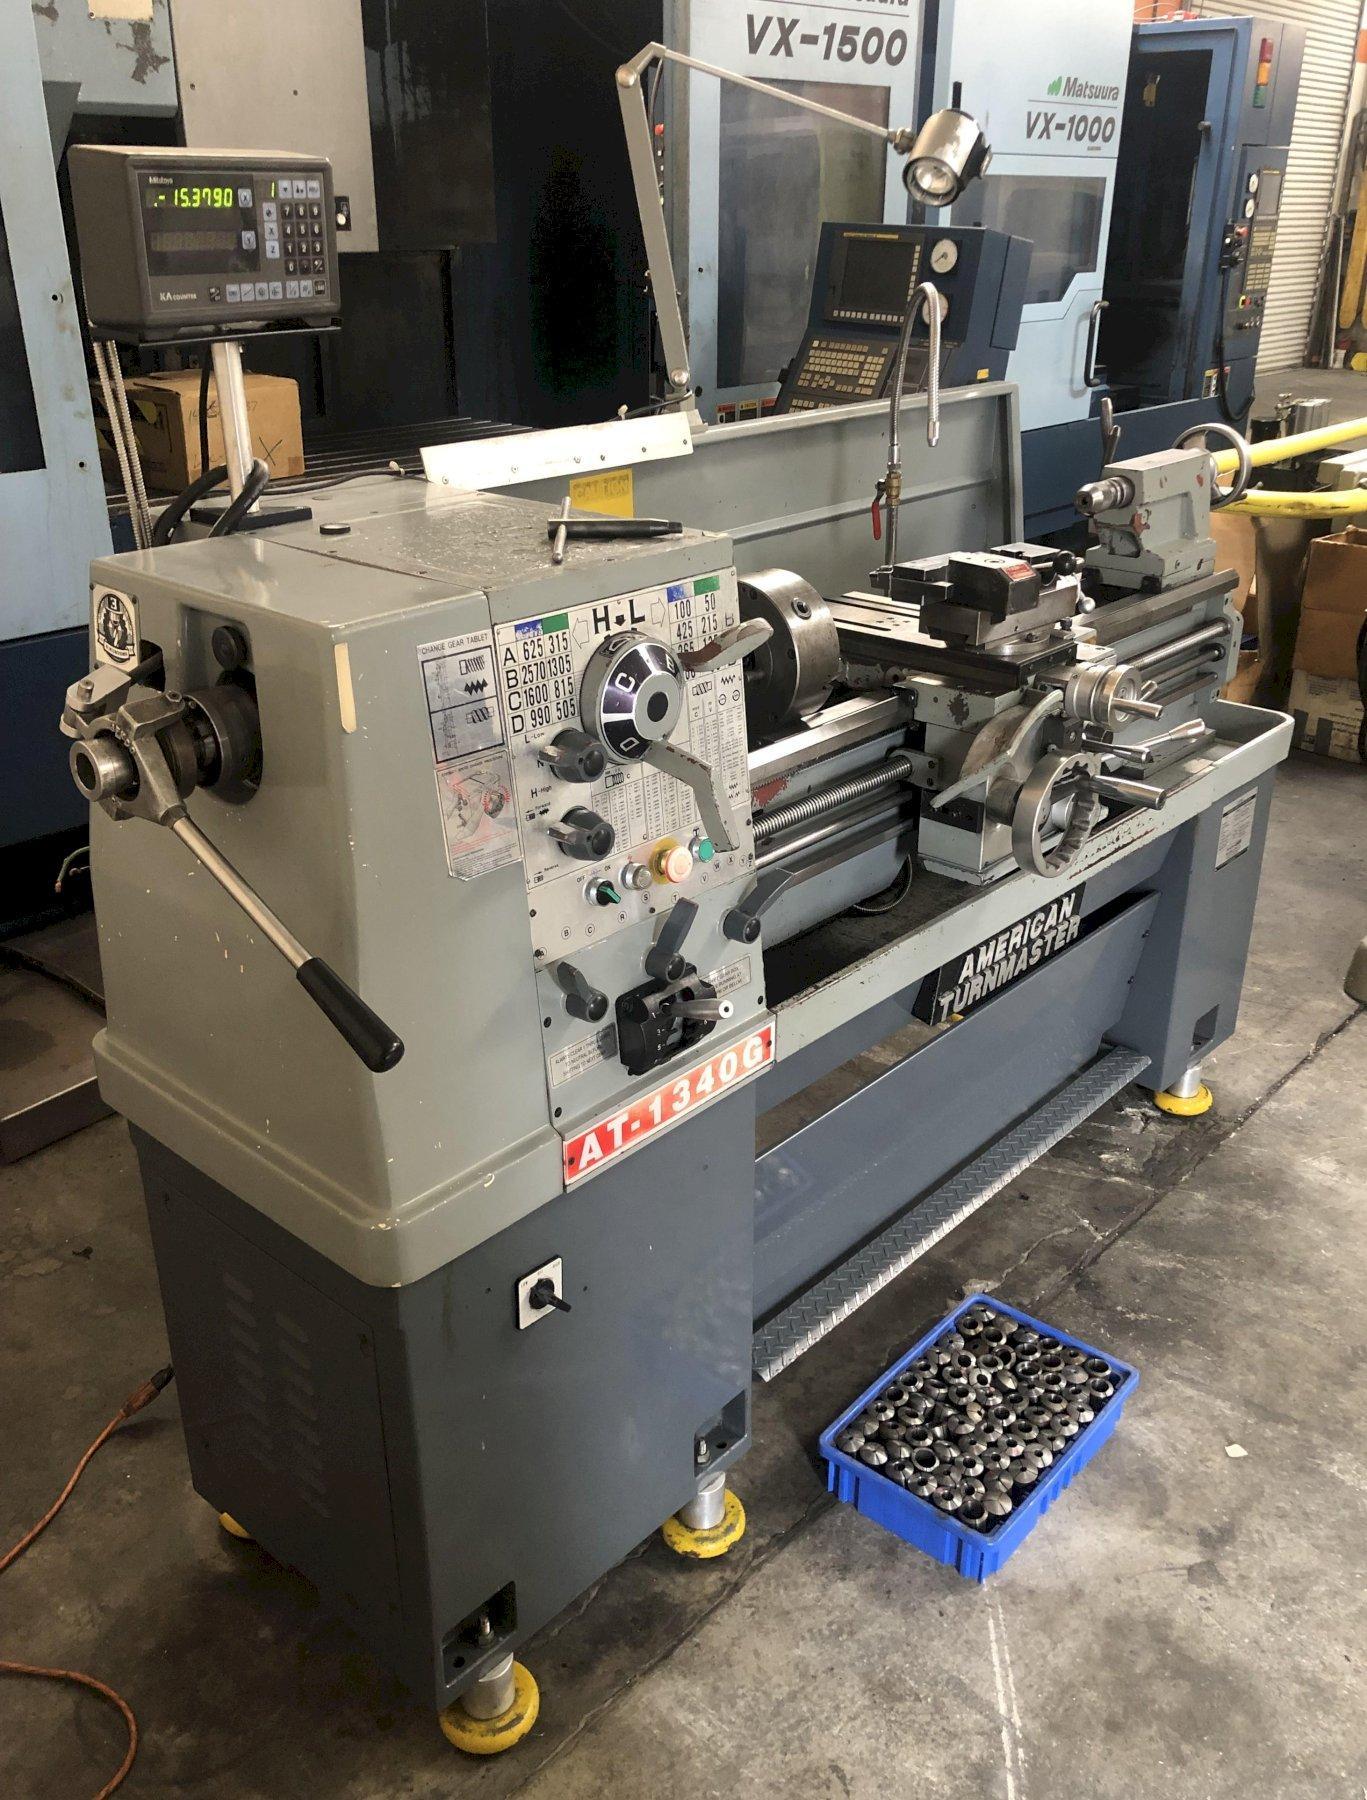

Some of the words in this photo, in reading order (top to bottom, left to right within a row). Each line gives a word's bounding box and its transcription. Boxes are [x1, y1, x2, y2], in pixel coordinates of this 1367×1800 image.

[746, 13, 908, 67] VX-1500
[1063, 76, 1120, 101] Matsuura
[1026, 111, 1116, 143] VX-1000
[592, 604, 611, 635] H
[628, 598, 646, 625] L
[674, 599, 692, 620] 100
[704, 592, 716, 612] 50
[421, 641, 446, 655] CHANGE
[447, 638, 464, 649] GEAR
[466, 632, 488, 645] TABLET
[676, 620, 693, 641] 425
[701, 613, 718, 634] 215
[503, 647, 517, 667] A
[522, 638, 544, 661] 625
[548, 631, 569, 654] 315
[505, 669, 519, 690] B
[521, 661, 546, 685] 2570
[547, 654, 572, 678] 1305
[614, 672, 636, 693] C
[508, 691, 522, 711] C
[523, 683, 549, 708] 1600
[554, 676, 574, 699] 815
[511, 714, 525, 734] D
[530, 705, 551, 728] 990
[556, 698, 576, 720] 505
[576, 875, 586, 883] OFF
[604, 864, 612, 872] ON
[957, 892, 1076, 984] AMERICAN
[938, 914, 1081, 1022] TURNMASTER
[578, 1035, 764, 1171] AT-1340G
